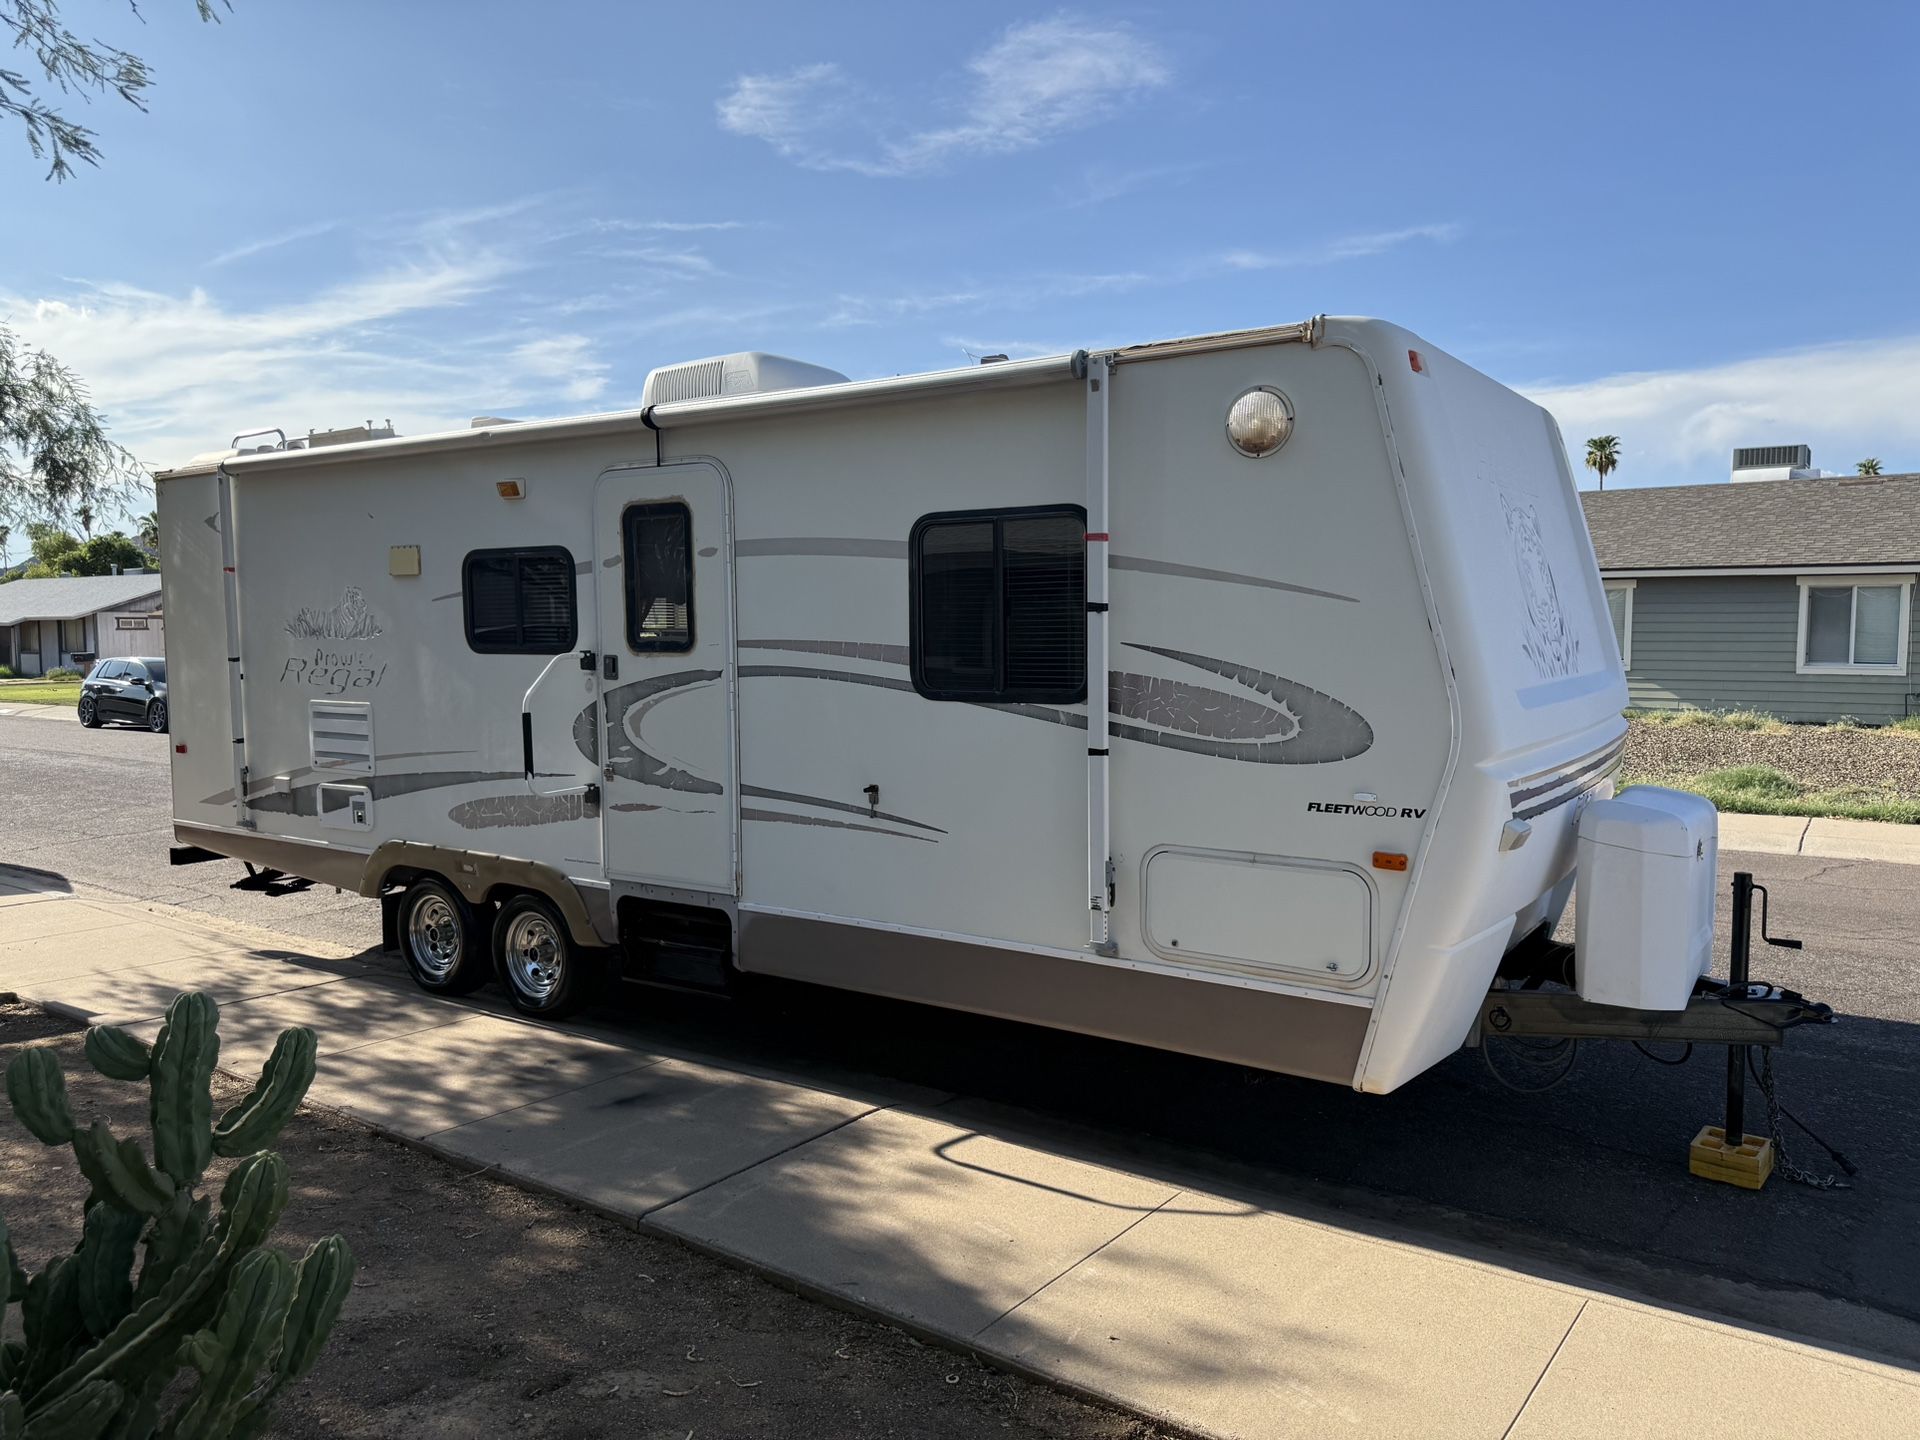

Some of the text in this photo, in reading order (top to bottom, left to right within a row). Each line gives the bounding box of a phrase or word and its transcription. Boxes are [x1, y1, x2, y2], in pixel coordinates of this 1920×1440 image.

[315, 648, 374, 667] Prowl
[280, 658, 387, 695] Regal
[1307, 802, 1427, 819] FLEETWOOD RV
